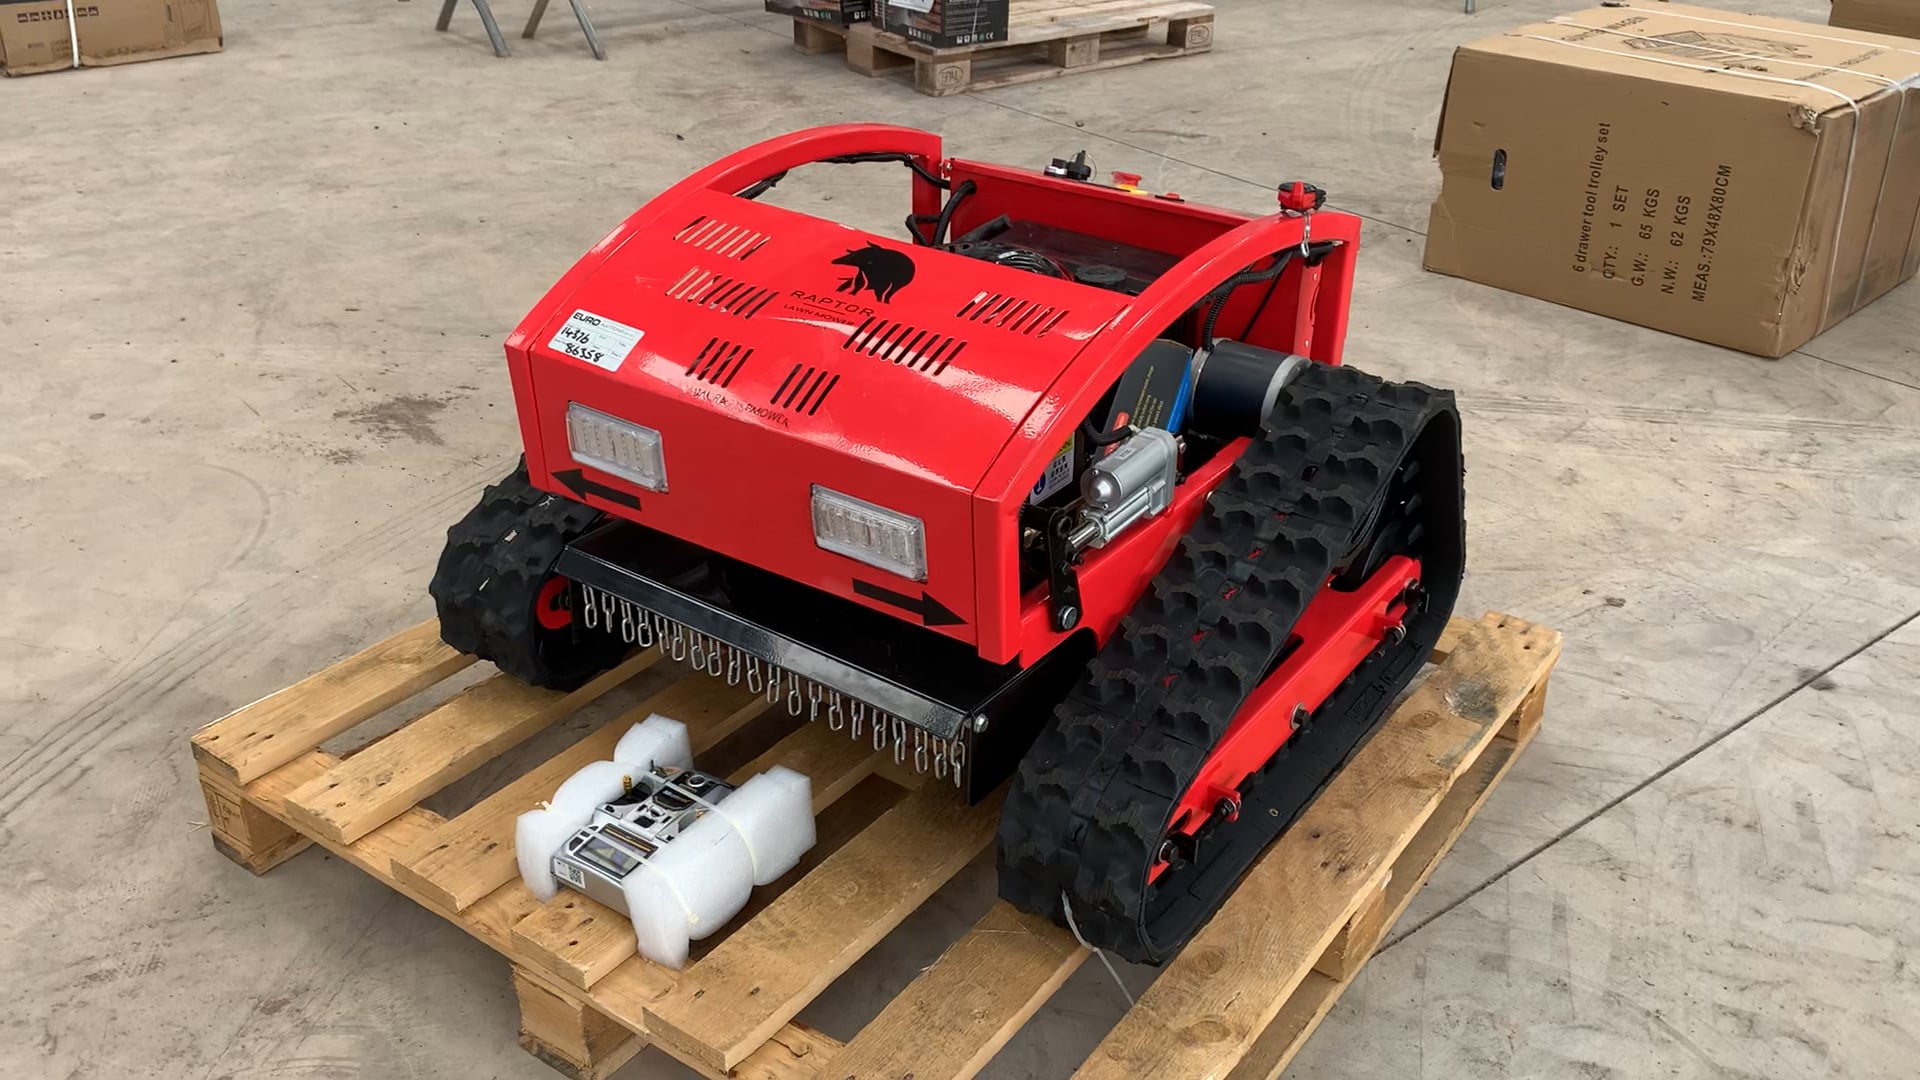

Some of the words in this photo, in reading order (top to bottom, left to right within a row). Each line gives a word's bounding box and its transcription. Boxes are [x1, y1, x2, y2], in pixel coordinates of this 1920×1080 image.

[1597, 122, 1611, 144] set
[1588, 145, 1608, 188] trolley
[1582, 190, 1598, 217] tool
[1612, 183, 1629, 213] SET
[1642, 188, 1660, 218] KGS
[1673, 195, 1691, 226] KGS
[1574, 219, 1592, 263] drawer
[1638, 223, 1653, 240] 65
[1670, 231, 1685, 248] 62
[1572, 264, 1585, 273] 6
[1631, 252, 1649, 287] G.W.:
[1661, 260, 1680, 295] N.W.:
[783, 303, 814, 315] LAWN
[790, 289, 875, 318] RAPTOR
[572, 311, 602, 327] EURO
